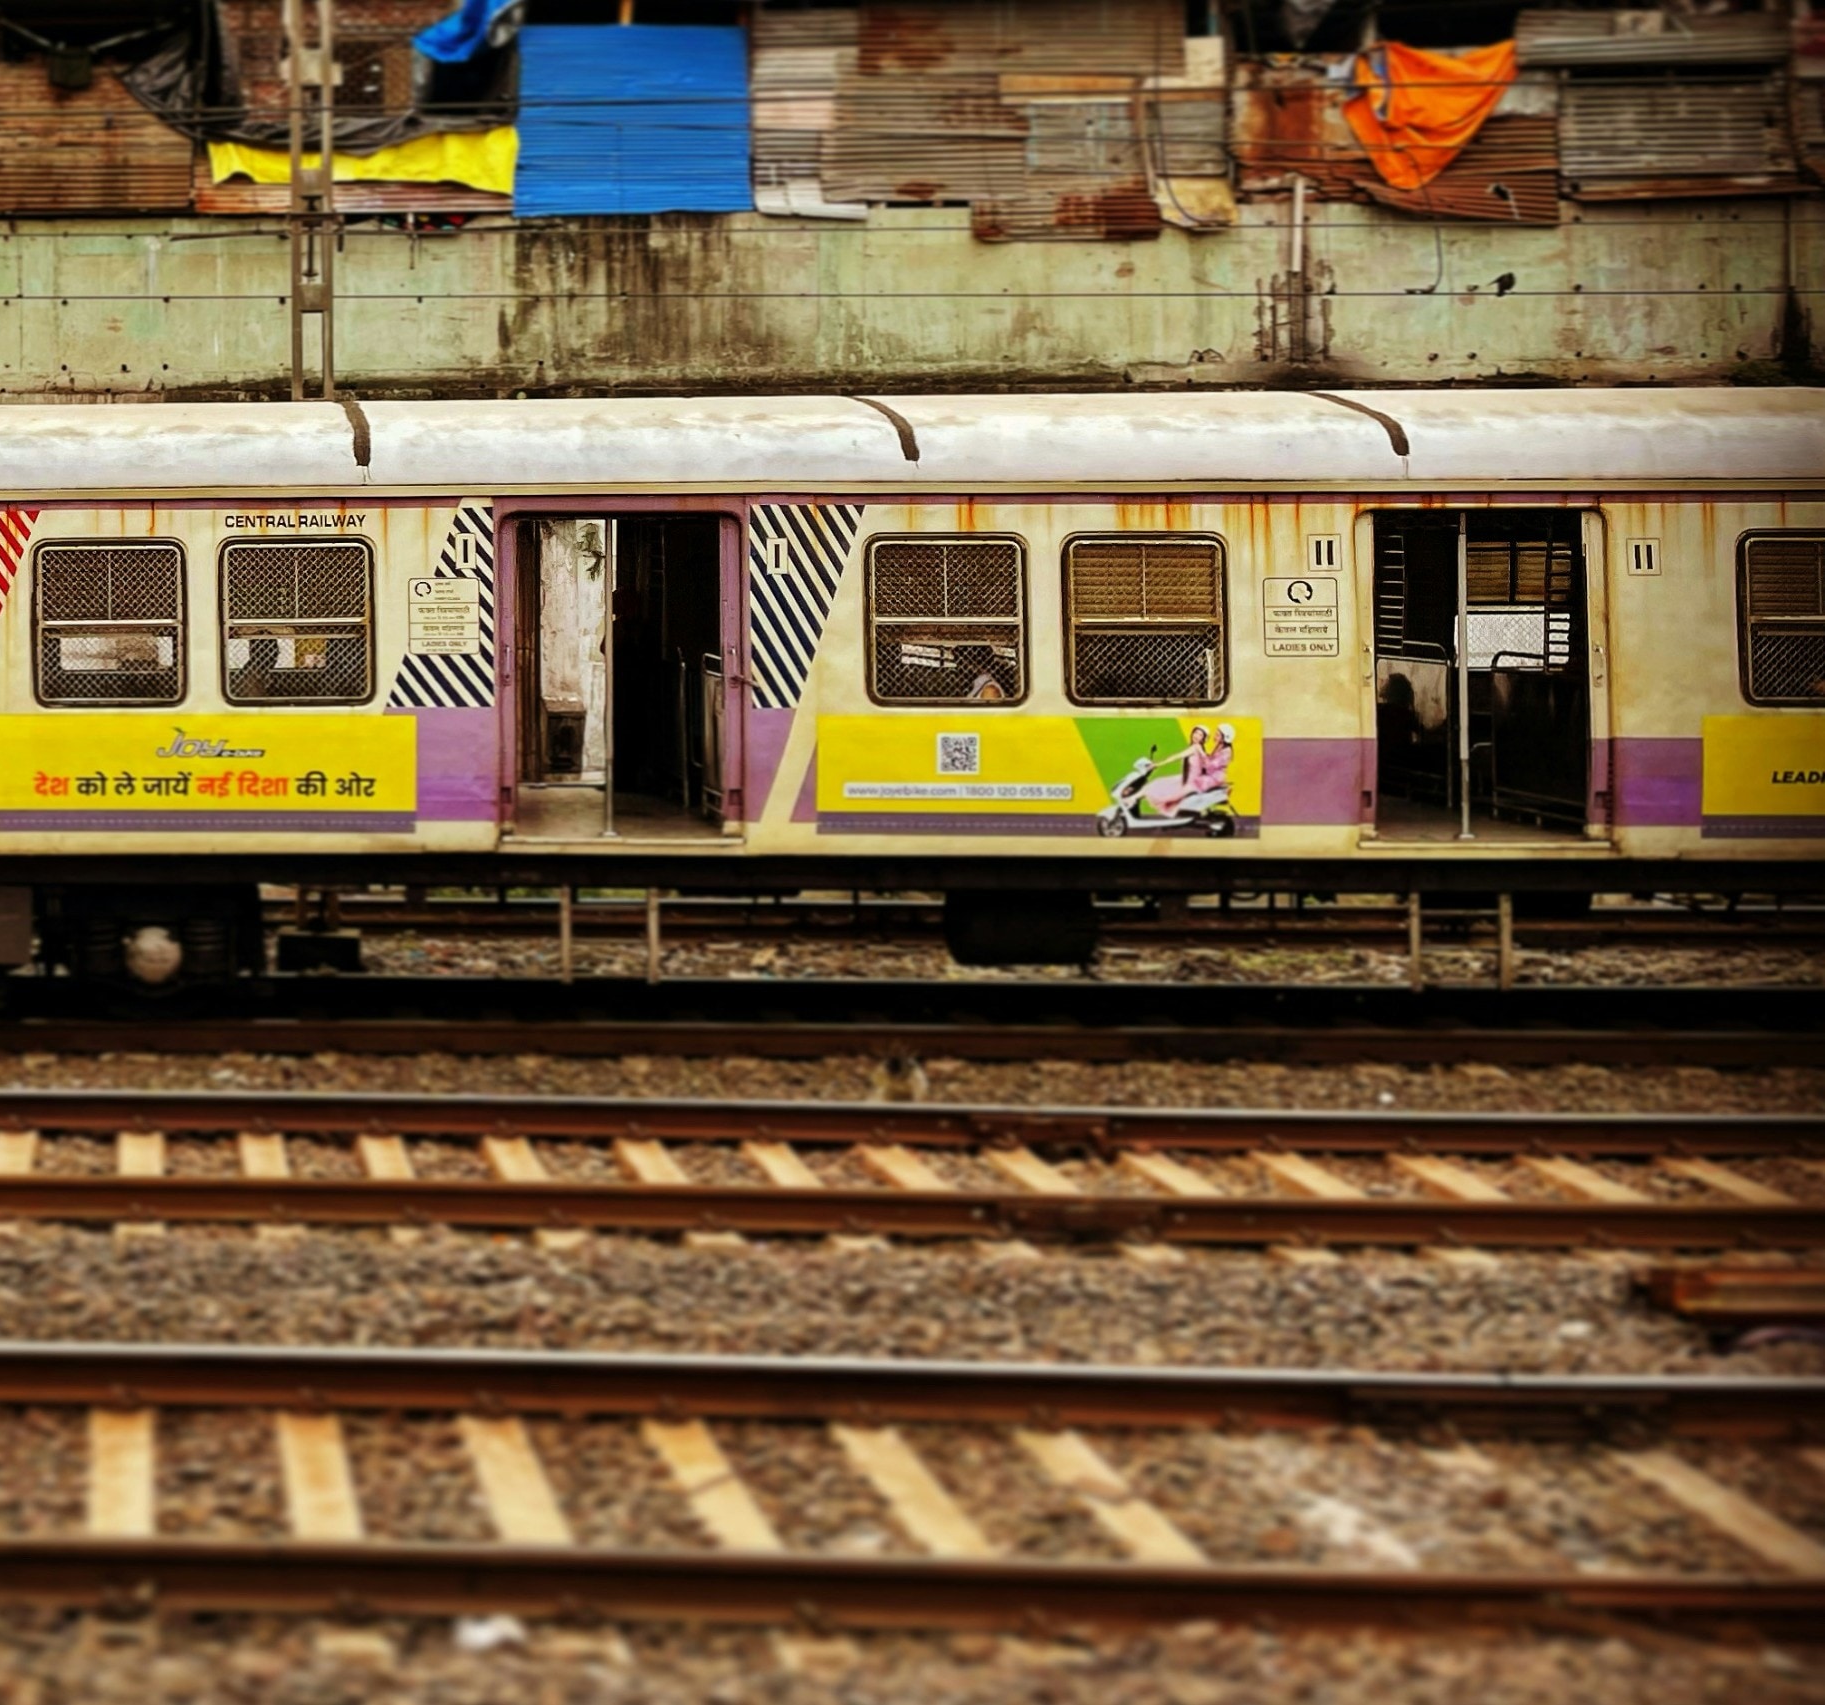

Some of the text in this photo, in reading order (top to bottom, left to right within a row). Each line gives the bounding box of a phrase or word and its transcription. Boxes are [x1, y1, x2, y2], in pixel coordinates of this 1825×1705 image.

[225, 514, 366, 528] CENTRAL RAILWAY
[1272, 643, 1334, 652] LADIES ONLY
[34, 770, 376, 798] देश को ले जायें नई दिशा की ओर
[966, 786, 994, 797] 1800
[997, 786, 1017, 797] 120
[1020, 786, 1043, 797] 055
[1046, 786, 1070, 797] 500
